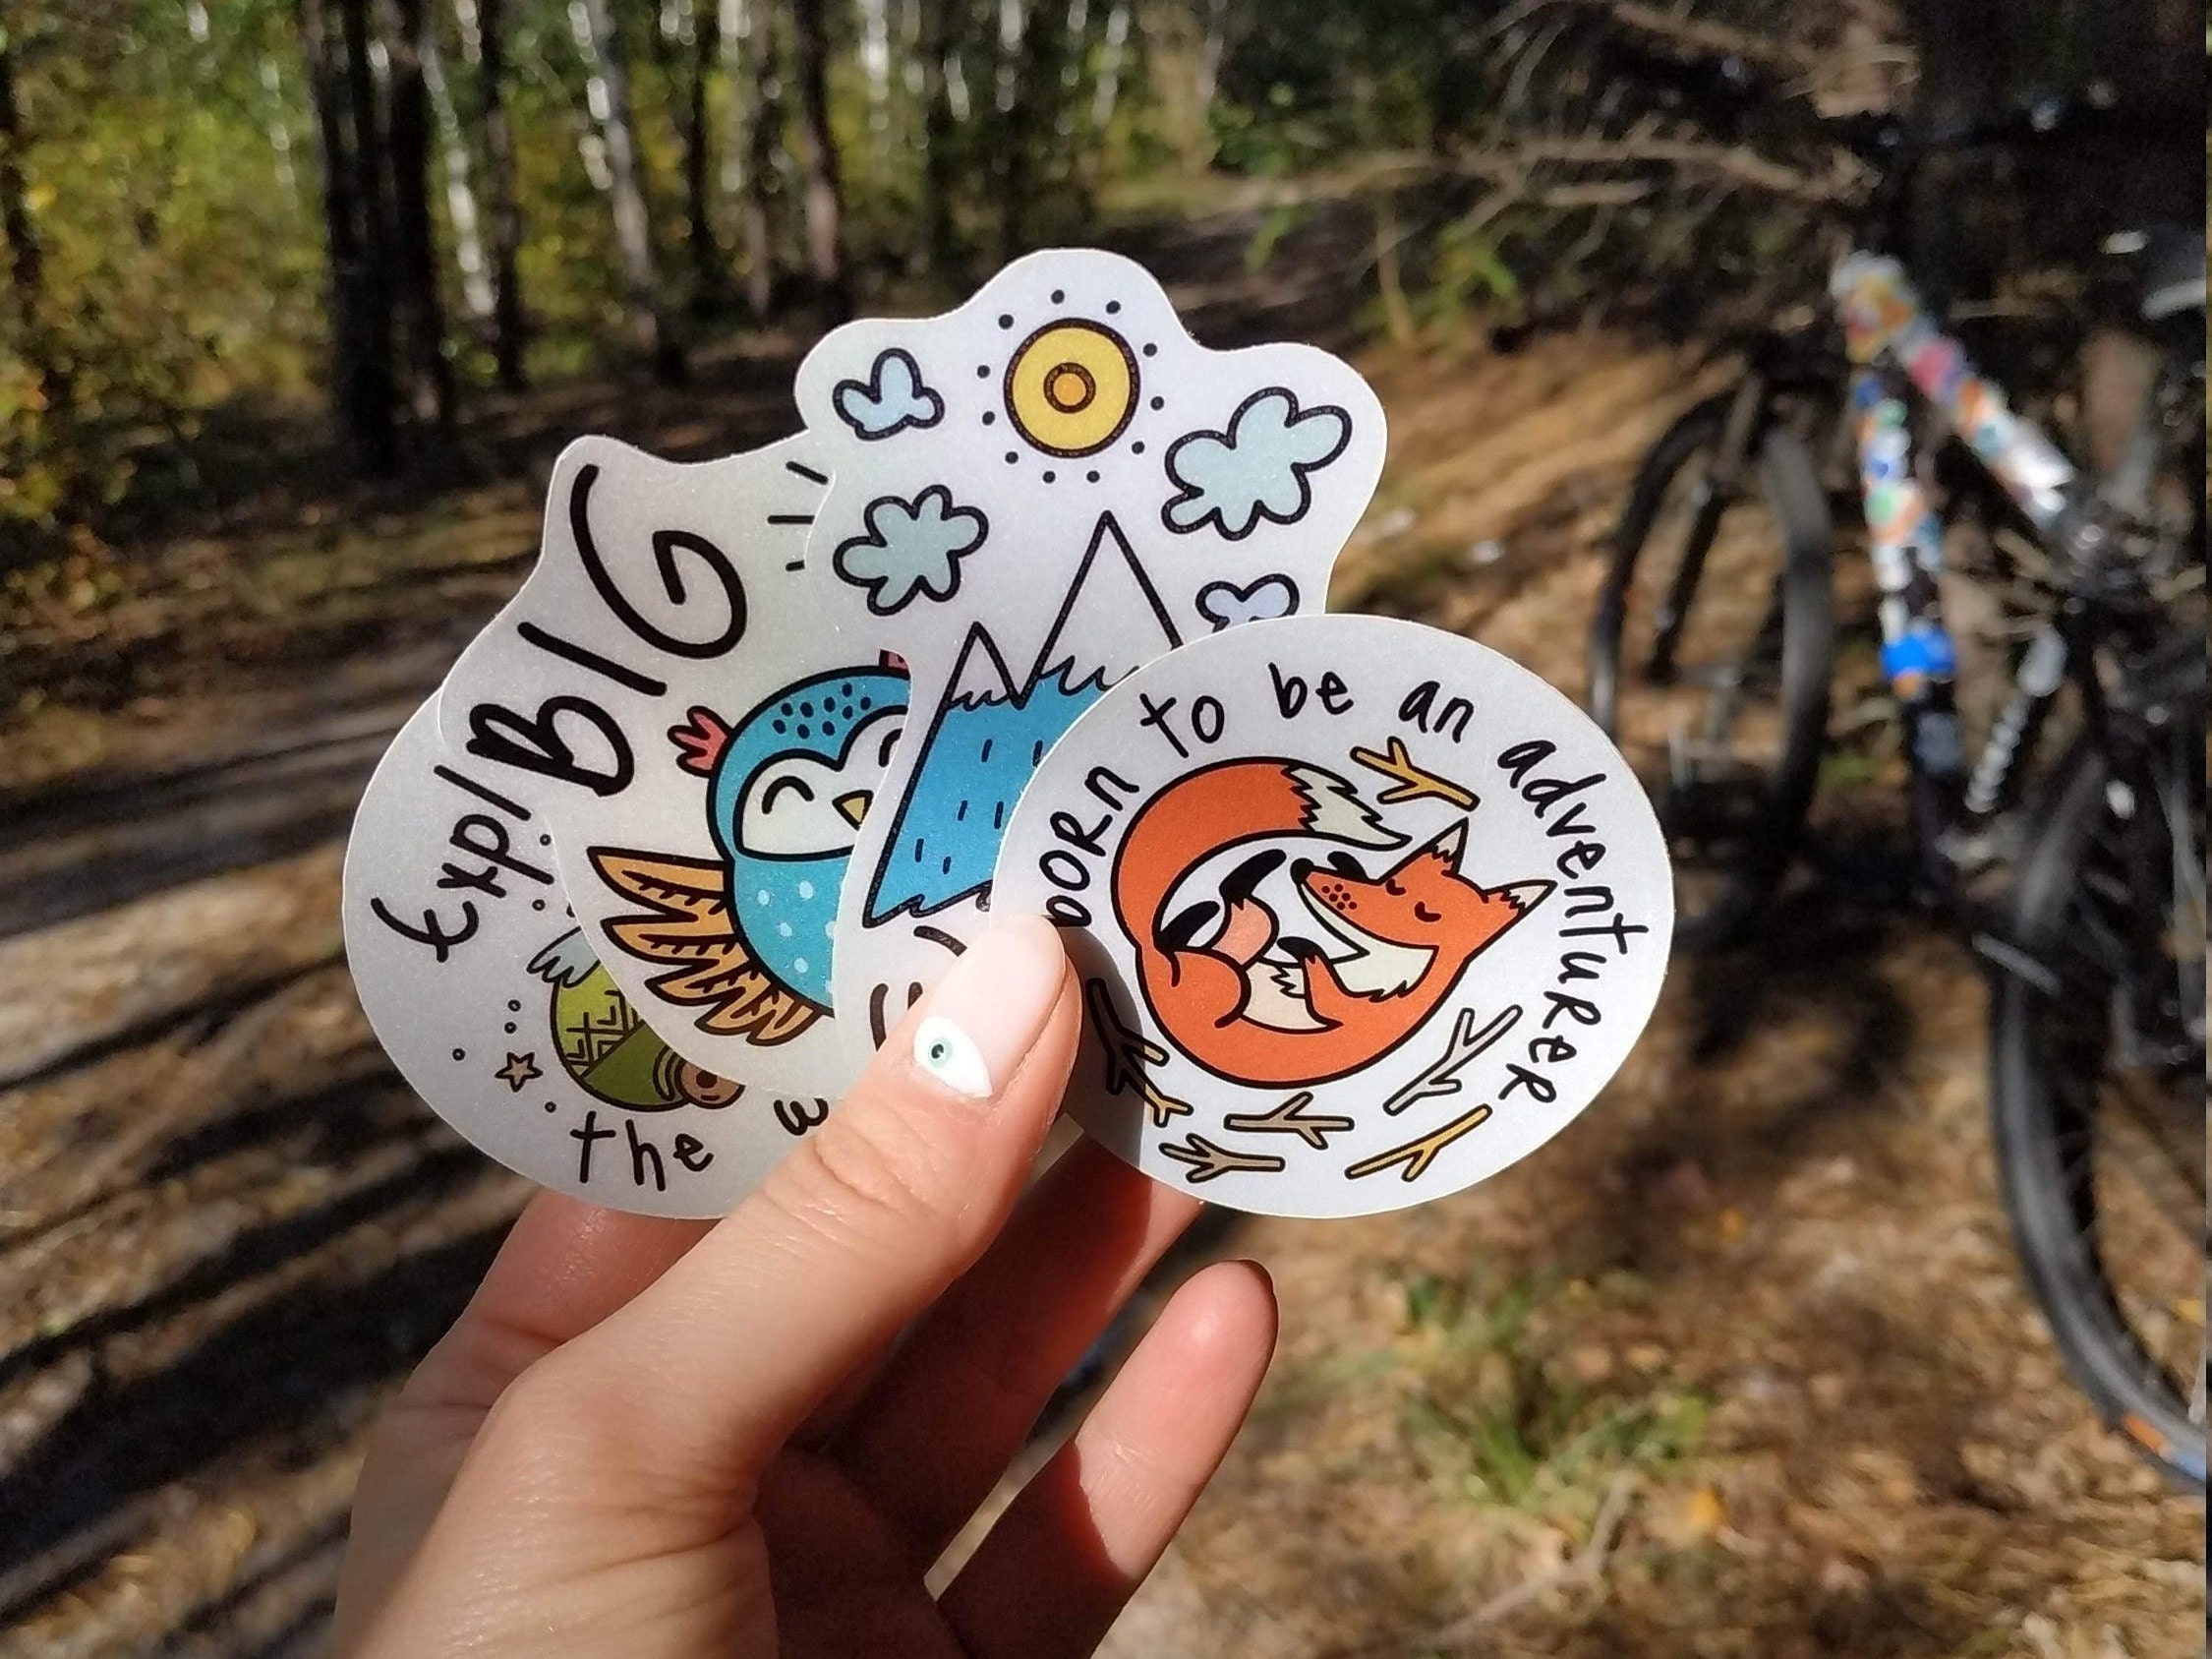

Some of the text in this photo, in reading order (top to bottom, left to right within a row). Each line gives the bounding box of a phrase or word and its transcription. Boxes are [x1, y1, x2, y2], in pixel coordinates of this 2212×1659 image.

[466, 464, 747, 798] BIG
[1139, 692, 1226, 757] to
[1267, 662, 1354, 719] be
[1397, 681, 1475, 742] an
[370, 764, 554, 963] Expl
[569, 1110, 715, 1192] the
